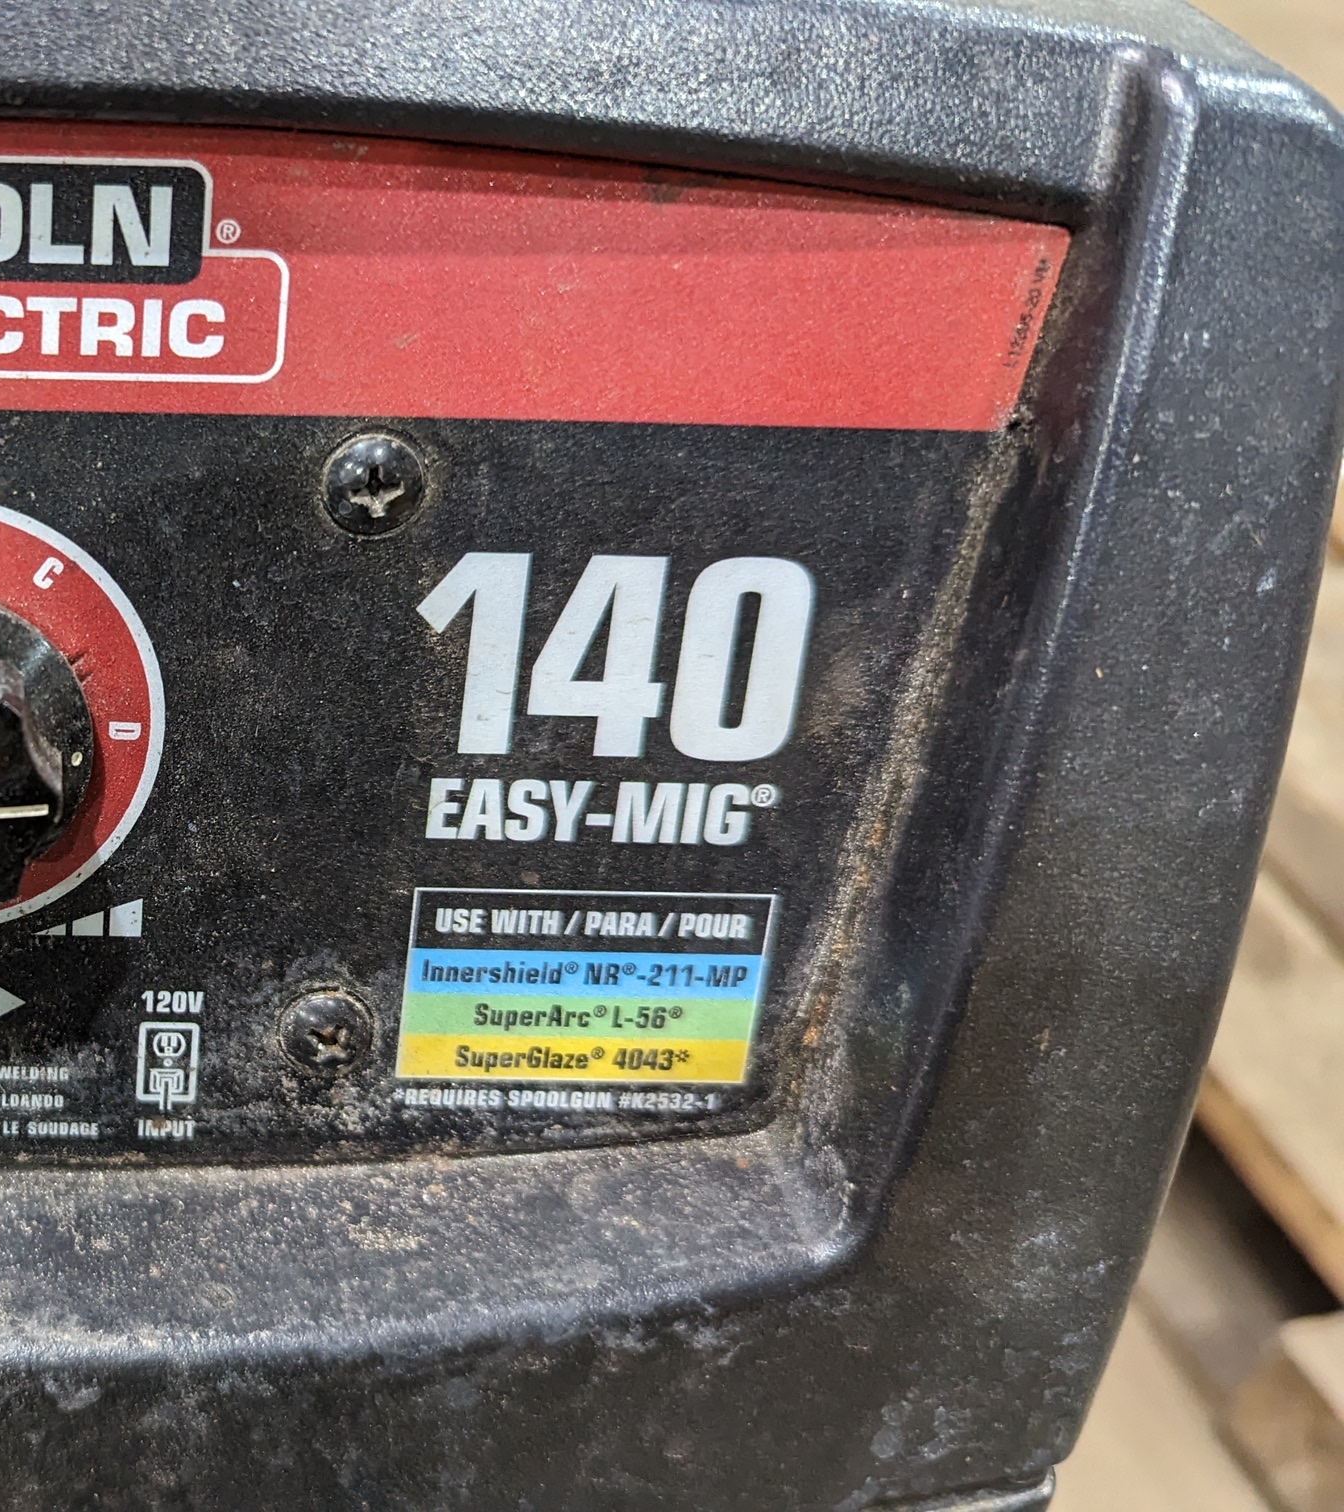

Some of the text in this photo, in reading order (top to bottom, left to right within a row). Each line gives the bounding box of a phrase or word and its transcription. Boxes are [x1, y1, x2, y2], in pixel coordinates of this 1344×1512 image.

[32, 556, 65, 590] C
[415, 551, 816, 762] 140
[108, 721, 142, 741] D
[435, 907, 485, 934] USE
[491, 908, 558, 935] WITH
[584, 910, 653, 938] PARA
[678, 913, 749, 940] POUR
[140, 990, 204, 1014] 120V
[508, 1089, 611, 1109] SPOOLGUN
[618, 1091, 716, 1110] #K2532-1
[3, 1121, 19, 1135] LE
[27, 1121, 99, 1136] SOUDAGE
[137, 1119, 196, 1138] INPUT
